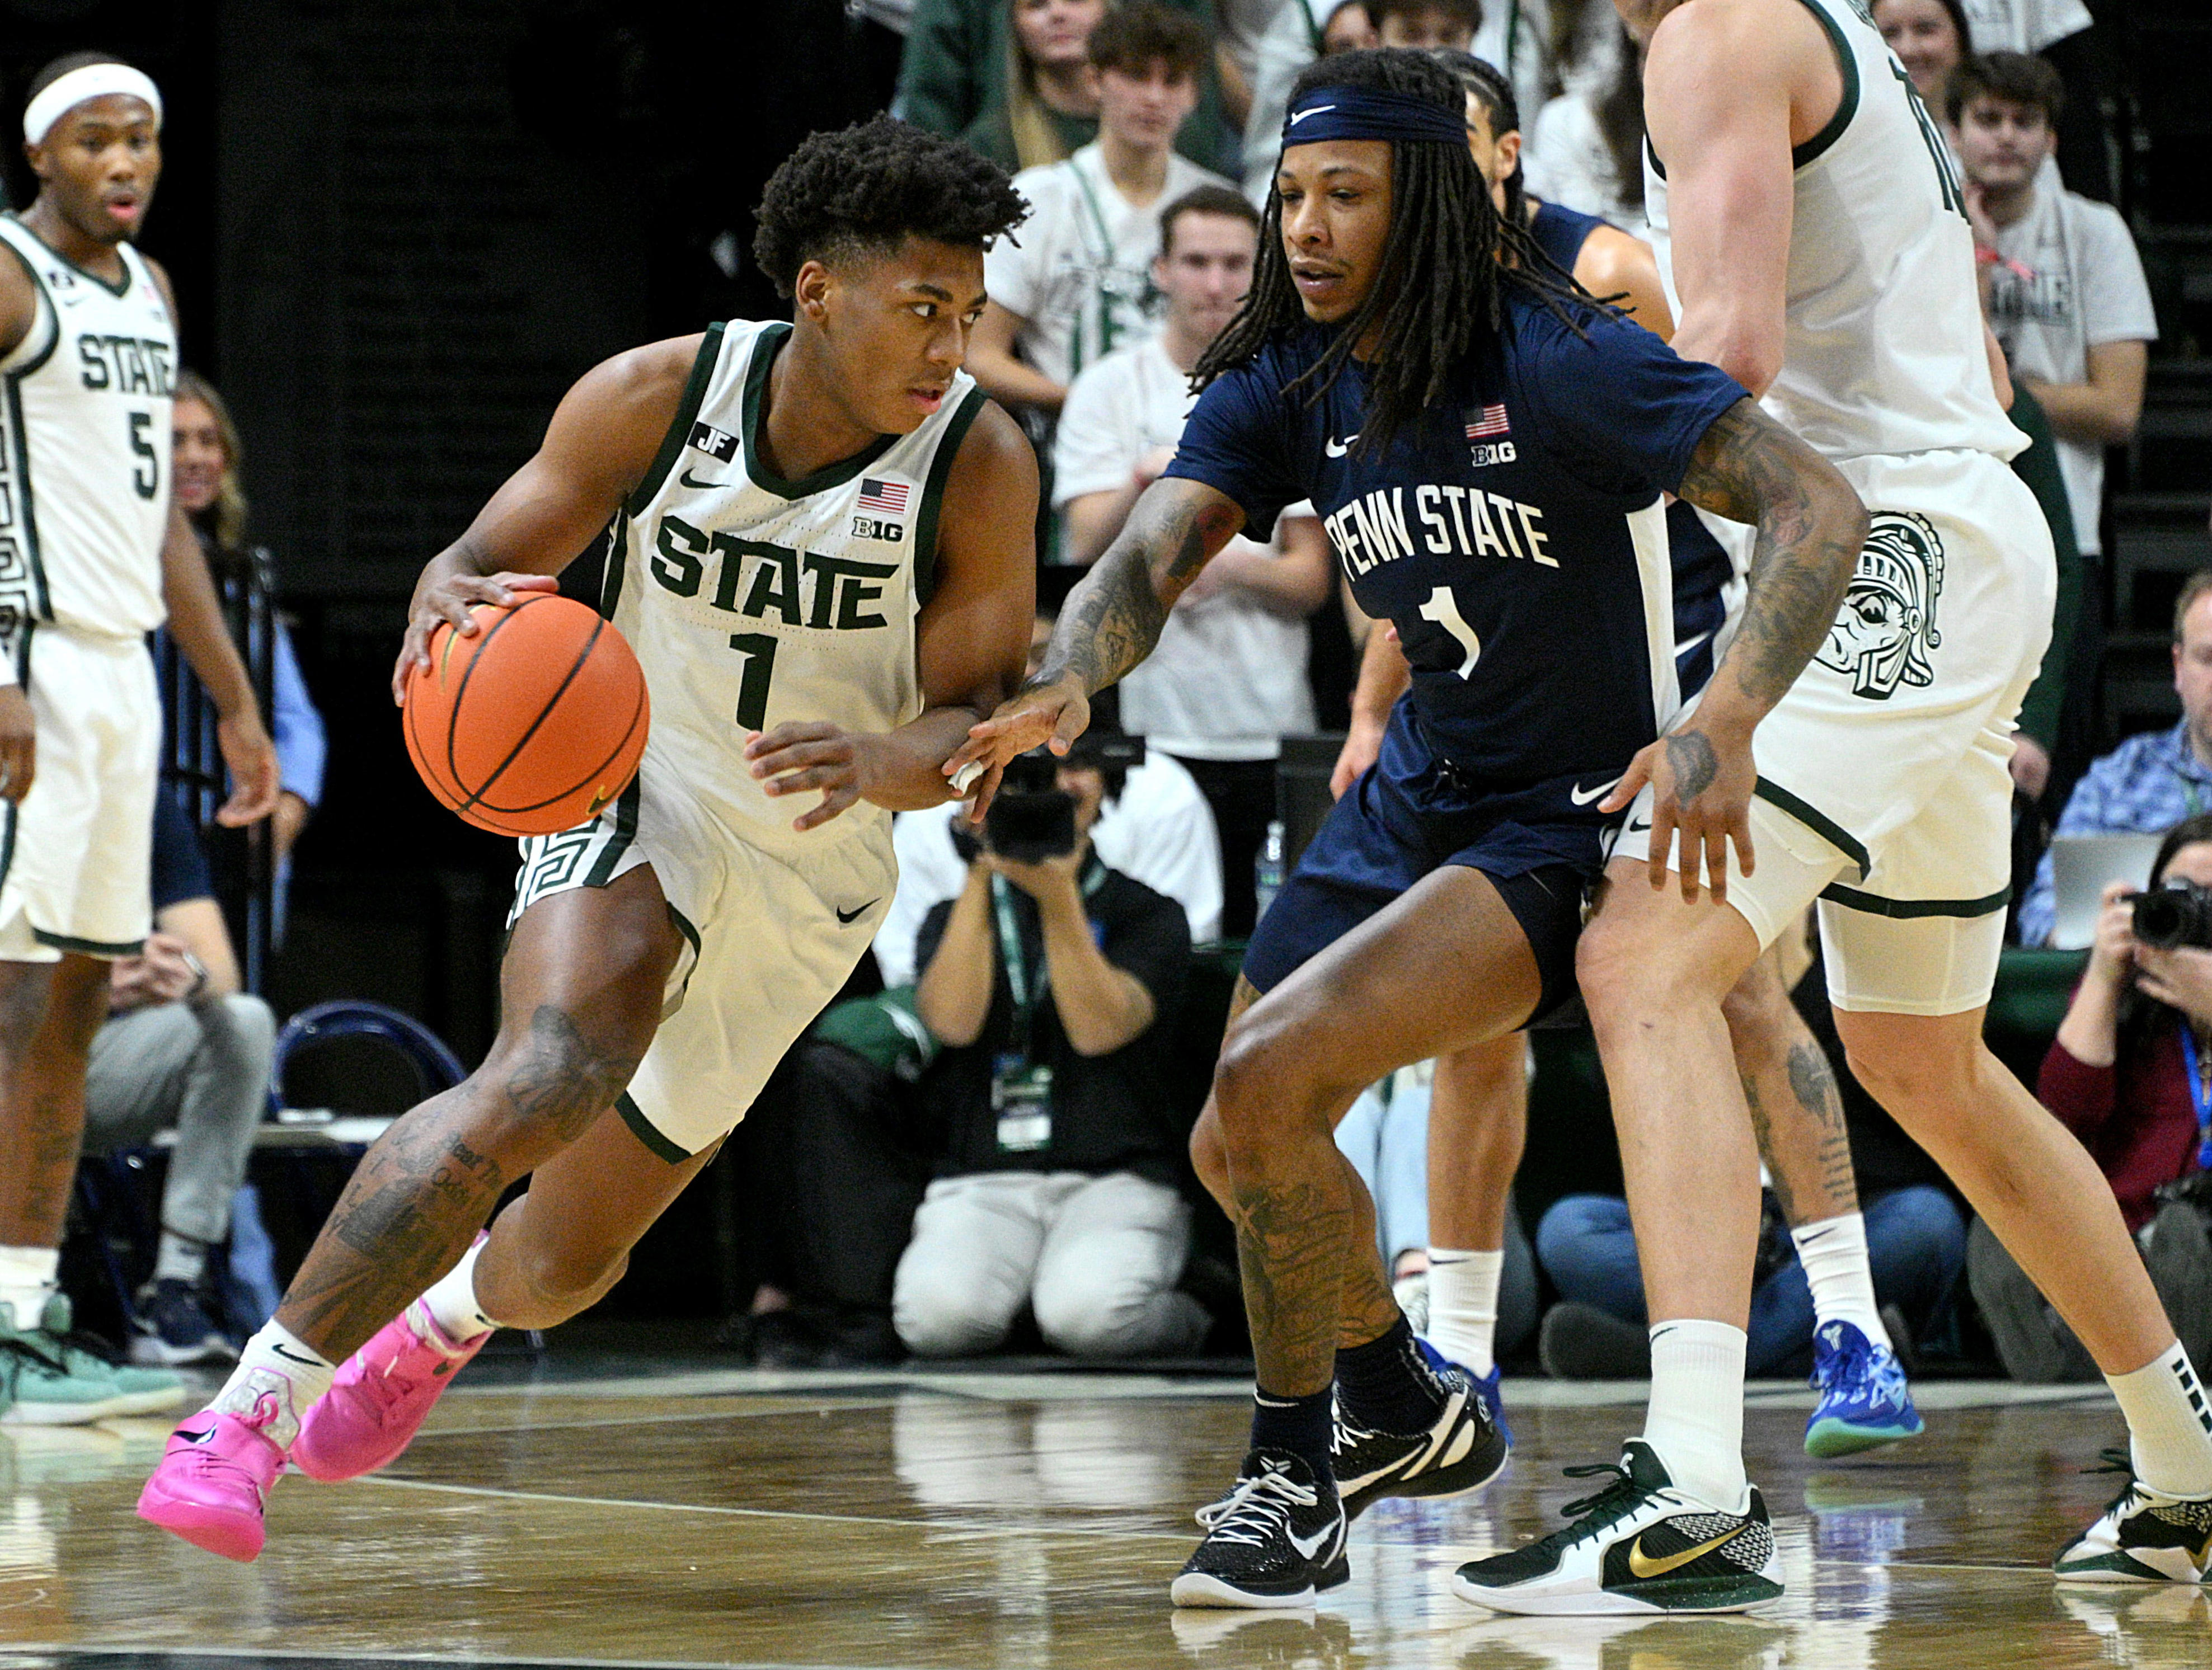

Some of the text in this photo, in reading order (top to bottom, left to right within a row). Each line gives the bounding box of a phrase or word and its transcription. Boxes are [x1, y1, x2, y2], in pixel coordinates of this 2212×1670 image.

[129, 410, 157, 499] 5
[697, 427, 731, 455] JF
[650, 515, 899, 630] STATE
[1323, 484, 1560, 582] PENN STATE
[1419, 586, 1481, 680] 1
[729, 633, 778, 732] 1
